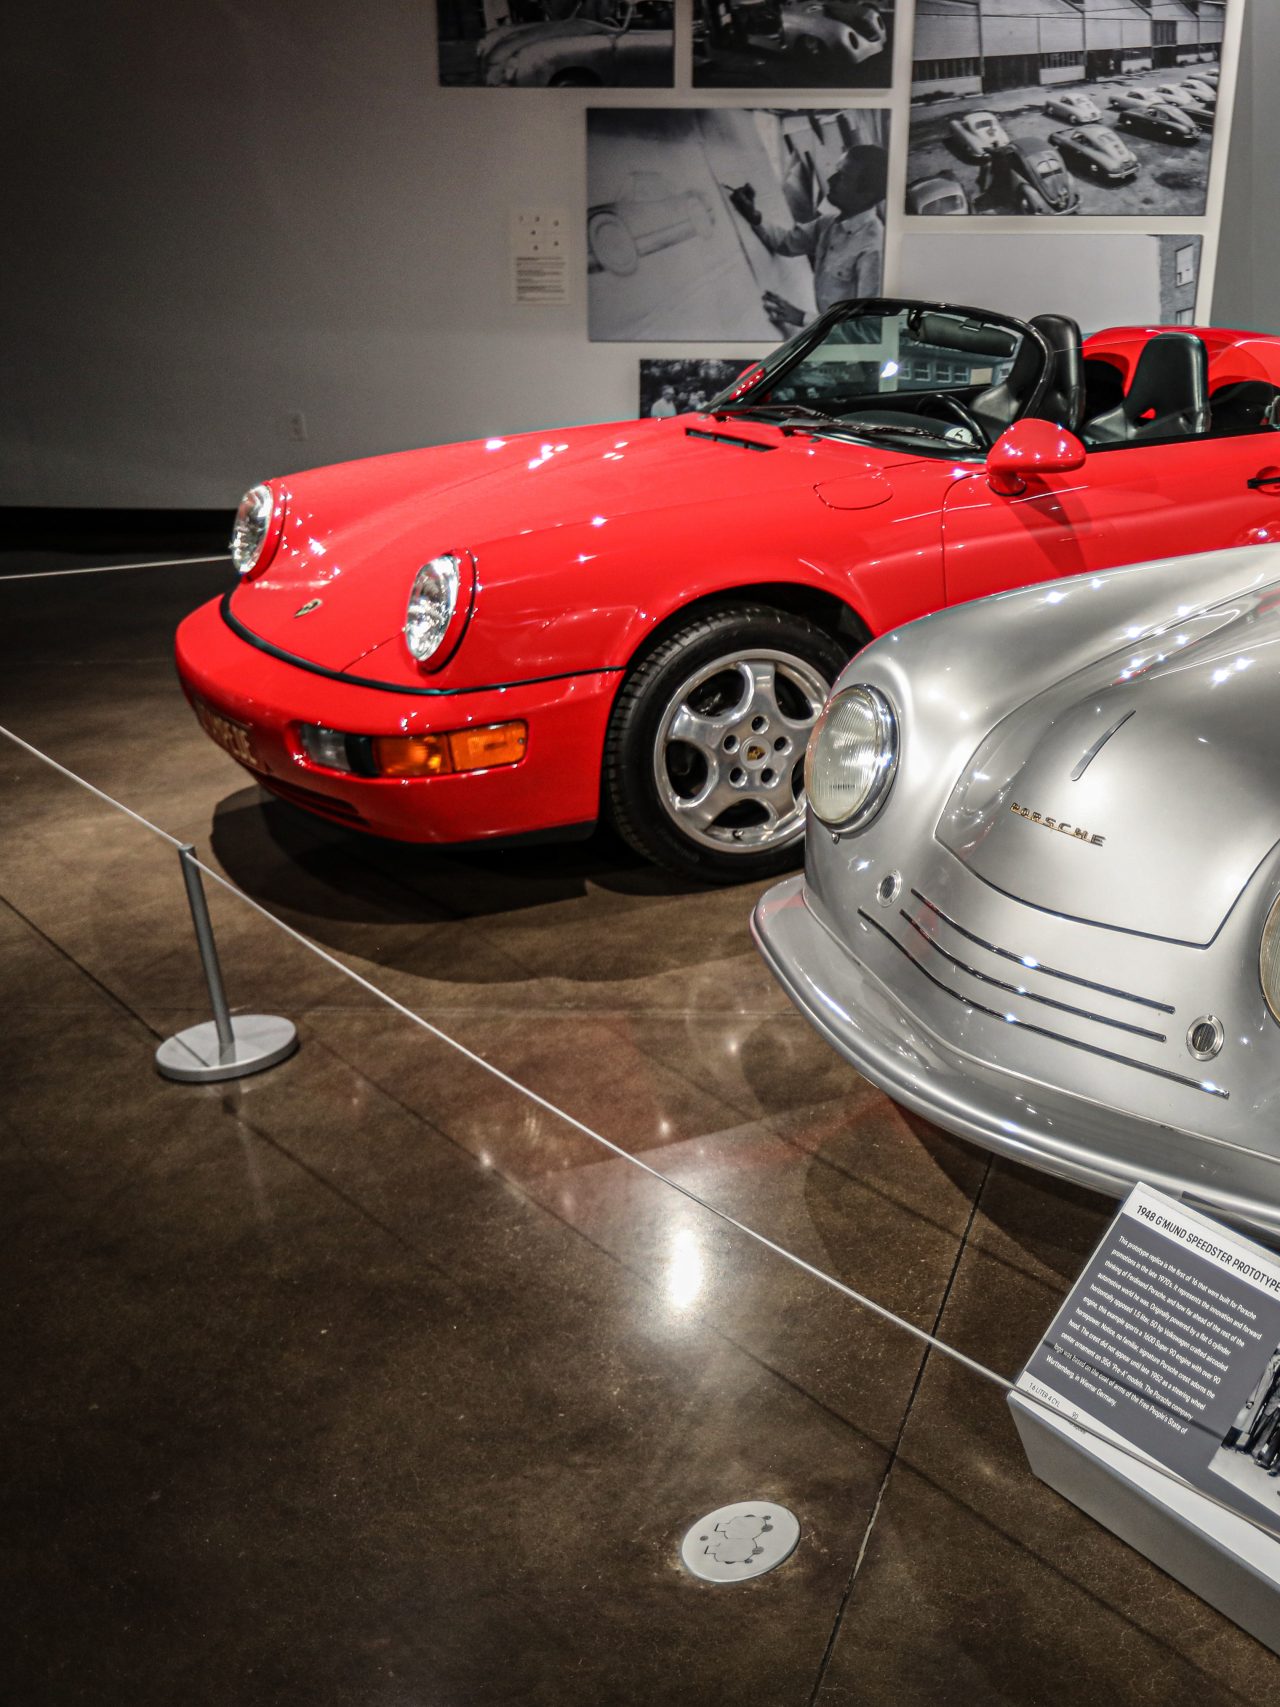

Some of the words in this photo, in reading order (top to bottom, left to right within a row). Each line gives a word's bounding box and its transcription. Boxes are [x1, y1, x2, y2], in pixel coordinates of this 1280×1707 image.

[1010, 802, 1106, 847] PORSCHE
[1136, 1205, 1156, 1221] 1948
[1185, 1232, 1232, 1264] SPEEDSTER
[1097, 1272, 1121, 1290] automotive
[1120, 1286, 1134, 1297] world
[1149, 1302, 1171, 1320] Originally
[1168, 1316, 1191, 1331] powered
[1199, 1332, 1208, 1342] flat
[1211, 1341, 1231, 1355] cylinder
[1104, 1260, 1122, 1275] thinking
[1126, 1272, 1149, 1289] Ferdinand
[1166, 1297, 1176, 1306] and
[1175, 1301, 1186, 1312] how
[1185, 1307, 1193, 1316] far
[1192, 1312, 1208, 1324] ahead
[1211, 1323, 1221, 1333] the
[1219, 1329, 1231, 1339] rest
[1235, 1338, 1244, 1347] the
[1110, 1248, 1136, 1266] promotions
[1140, 1265, 1148, 1273] the
[1147, 1268, 1157, 1278] late
[1177, 1287, 1202, 1304] represents
[1201, 1300, 1210, 1309] the
[1209, 1304, 1233, 1323] innovation
[1232, 1319, 1243, 1329] and
[1242, 1324, 1262, 1340] forward
[1118, 1235, 1128, 1245] This
[1126, 1242, 1149, 1257] prototype
[1148, 1254, 1164, 1266] replica
[1167, 1264, 1176, 1273] the
[1175, 1268, 1186, 1279] first
[1197, 1281, 1208, 1292] that
[1207, 1288, 1219, 1298] were
[1218, 1293, 1230, 1304] built
[1229, 1300, 1237, 1308] for
[1236, 1304, 1256, 1320] Porsche
[1089, 1283, 1115, 1303] horizontally
[1113, 1298, 1134, 1313] opposed
[1163, 1327, 1190, 1348] Volkswagen
[1189, 1345, 1207, 1358] crafted
[1098, 1305, 1107, 1314] this
[1106, 1310, 1125, 1325] example
[1124, 1322, 1139, 1334] sports
[1143, 1331, 1156, 1344] 1600
[1154, 1339, 1169, 1352] Super
[1175, 1353, 1191, 1366] engine
[1190, 1363, 1202, 1373] with
[1201, 1369, 1213, 1379] over
[1035, 1386, 1049, 1400] LITER
[1051, 1397, 1061, 1407] CYL
[1053, 1342, 1064, 1353] logo
[1063, 1350, 1072, 1359] was
[1071, 1354, 1086, 1368] based
[1090, 1368, 1099, 1377] the
[1098, 1373, 1109, 1383] coat
[1113, 1383, 1126, 1394] arms
[1130, 1393, 1139, 1403] the
[1138, 1398, 1150, 1410] Free
[1148, 1405, 1168, 1422] People's
[1167, 1417, 1181, 1430] State
[1060, 1332, 1075, 1344] center
[1074, 1340, 1096, 1357] ornament
[1100, 1356, 1111, 1367] 356
[1144, 1384, 1153, 1395] The
[1152, 1390, 1172, 1406] Porsche
[1170, 1403, 1194, 1420] company
[1080, 1326, 1089, 1336] The
[1088, 1333, 1101, 1343] crest
[1099, 1339, 1108, 1348] did
[1106, 1344, 1116, 1353] not
[1114, 1349, 1131, 1362] appear
[1129, 1359, 1142, 1369] until
[1140, 1364, 1150, 1375] late
[1150, 1370, 1163, 1383] 1952
[1171, 1385, 1191, 1402] steering
[1190, 1397, 1206, 1410] wheel
[1138, 1347, 1160, 1364] signature
[1159, 1359, 1178, 1376] Porsche
[1177, 1372, 1191, 1384] crest
[1189, 1380, 1206, 1393] adorns
[1206, 1389, 1215, 1399] the
